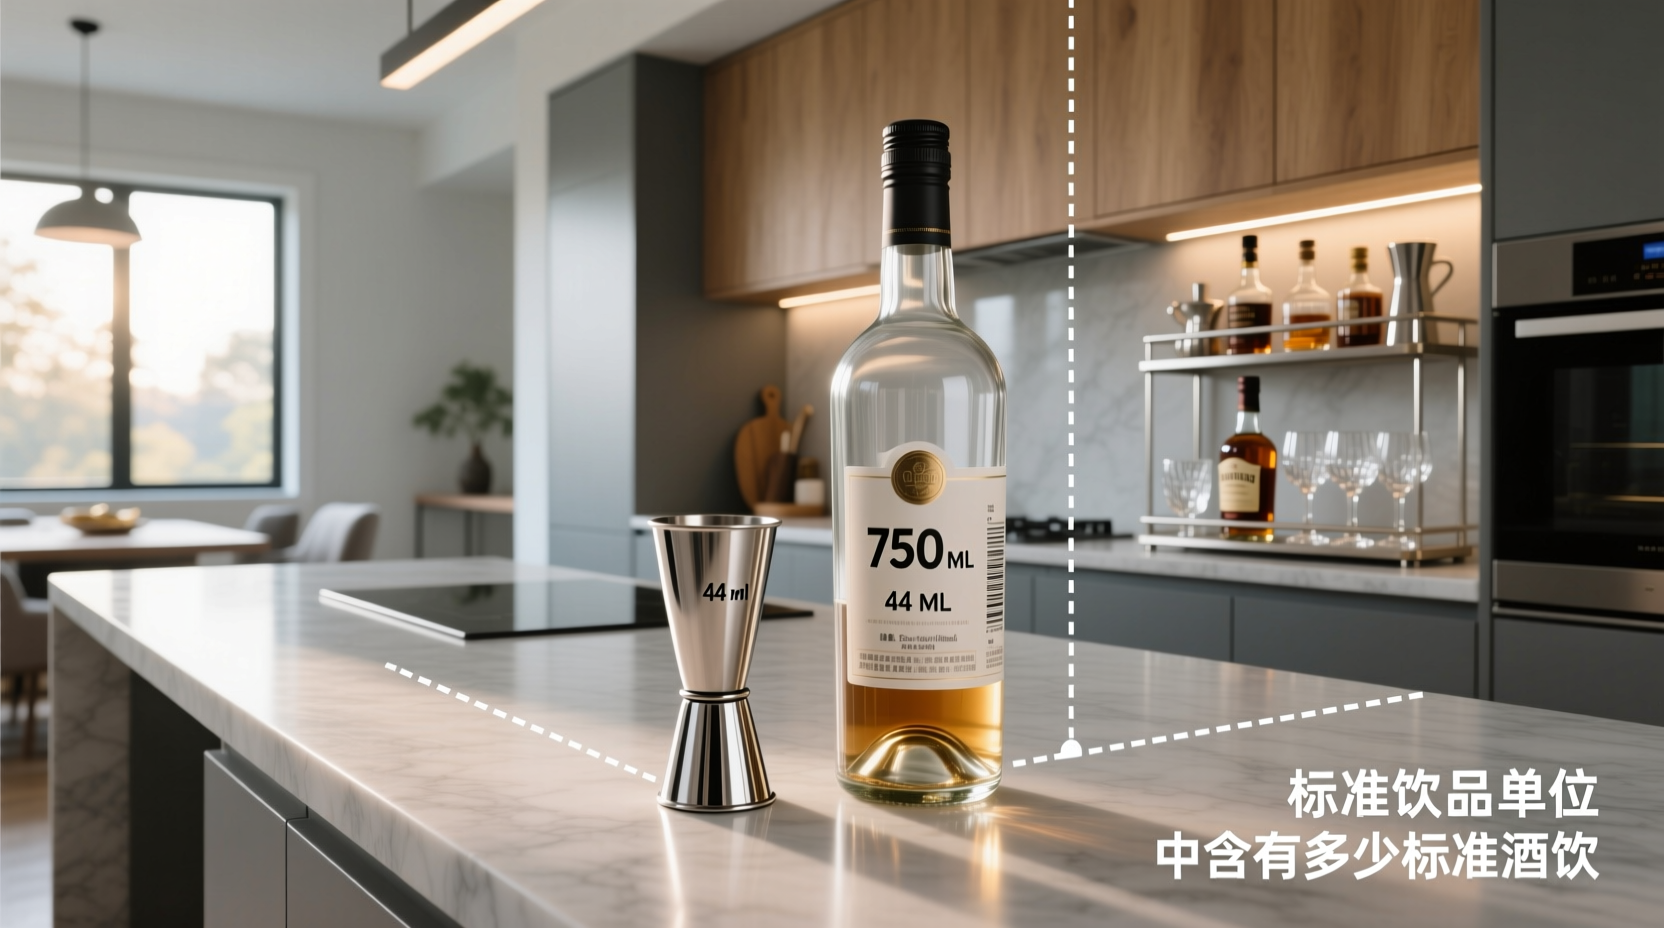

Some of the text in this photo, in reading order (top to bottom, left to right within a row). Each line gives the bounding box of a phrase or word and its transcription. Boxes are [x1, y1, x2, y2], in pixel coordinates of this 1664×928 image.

[867, 527, 975, 570] 750 ML
[702, 582, 749, 601] 44 ml
[884, 590, 952, 612] 44 ML
